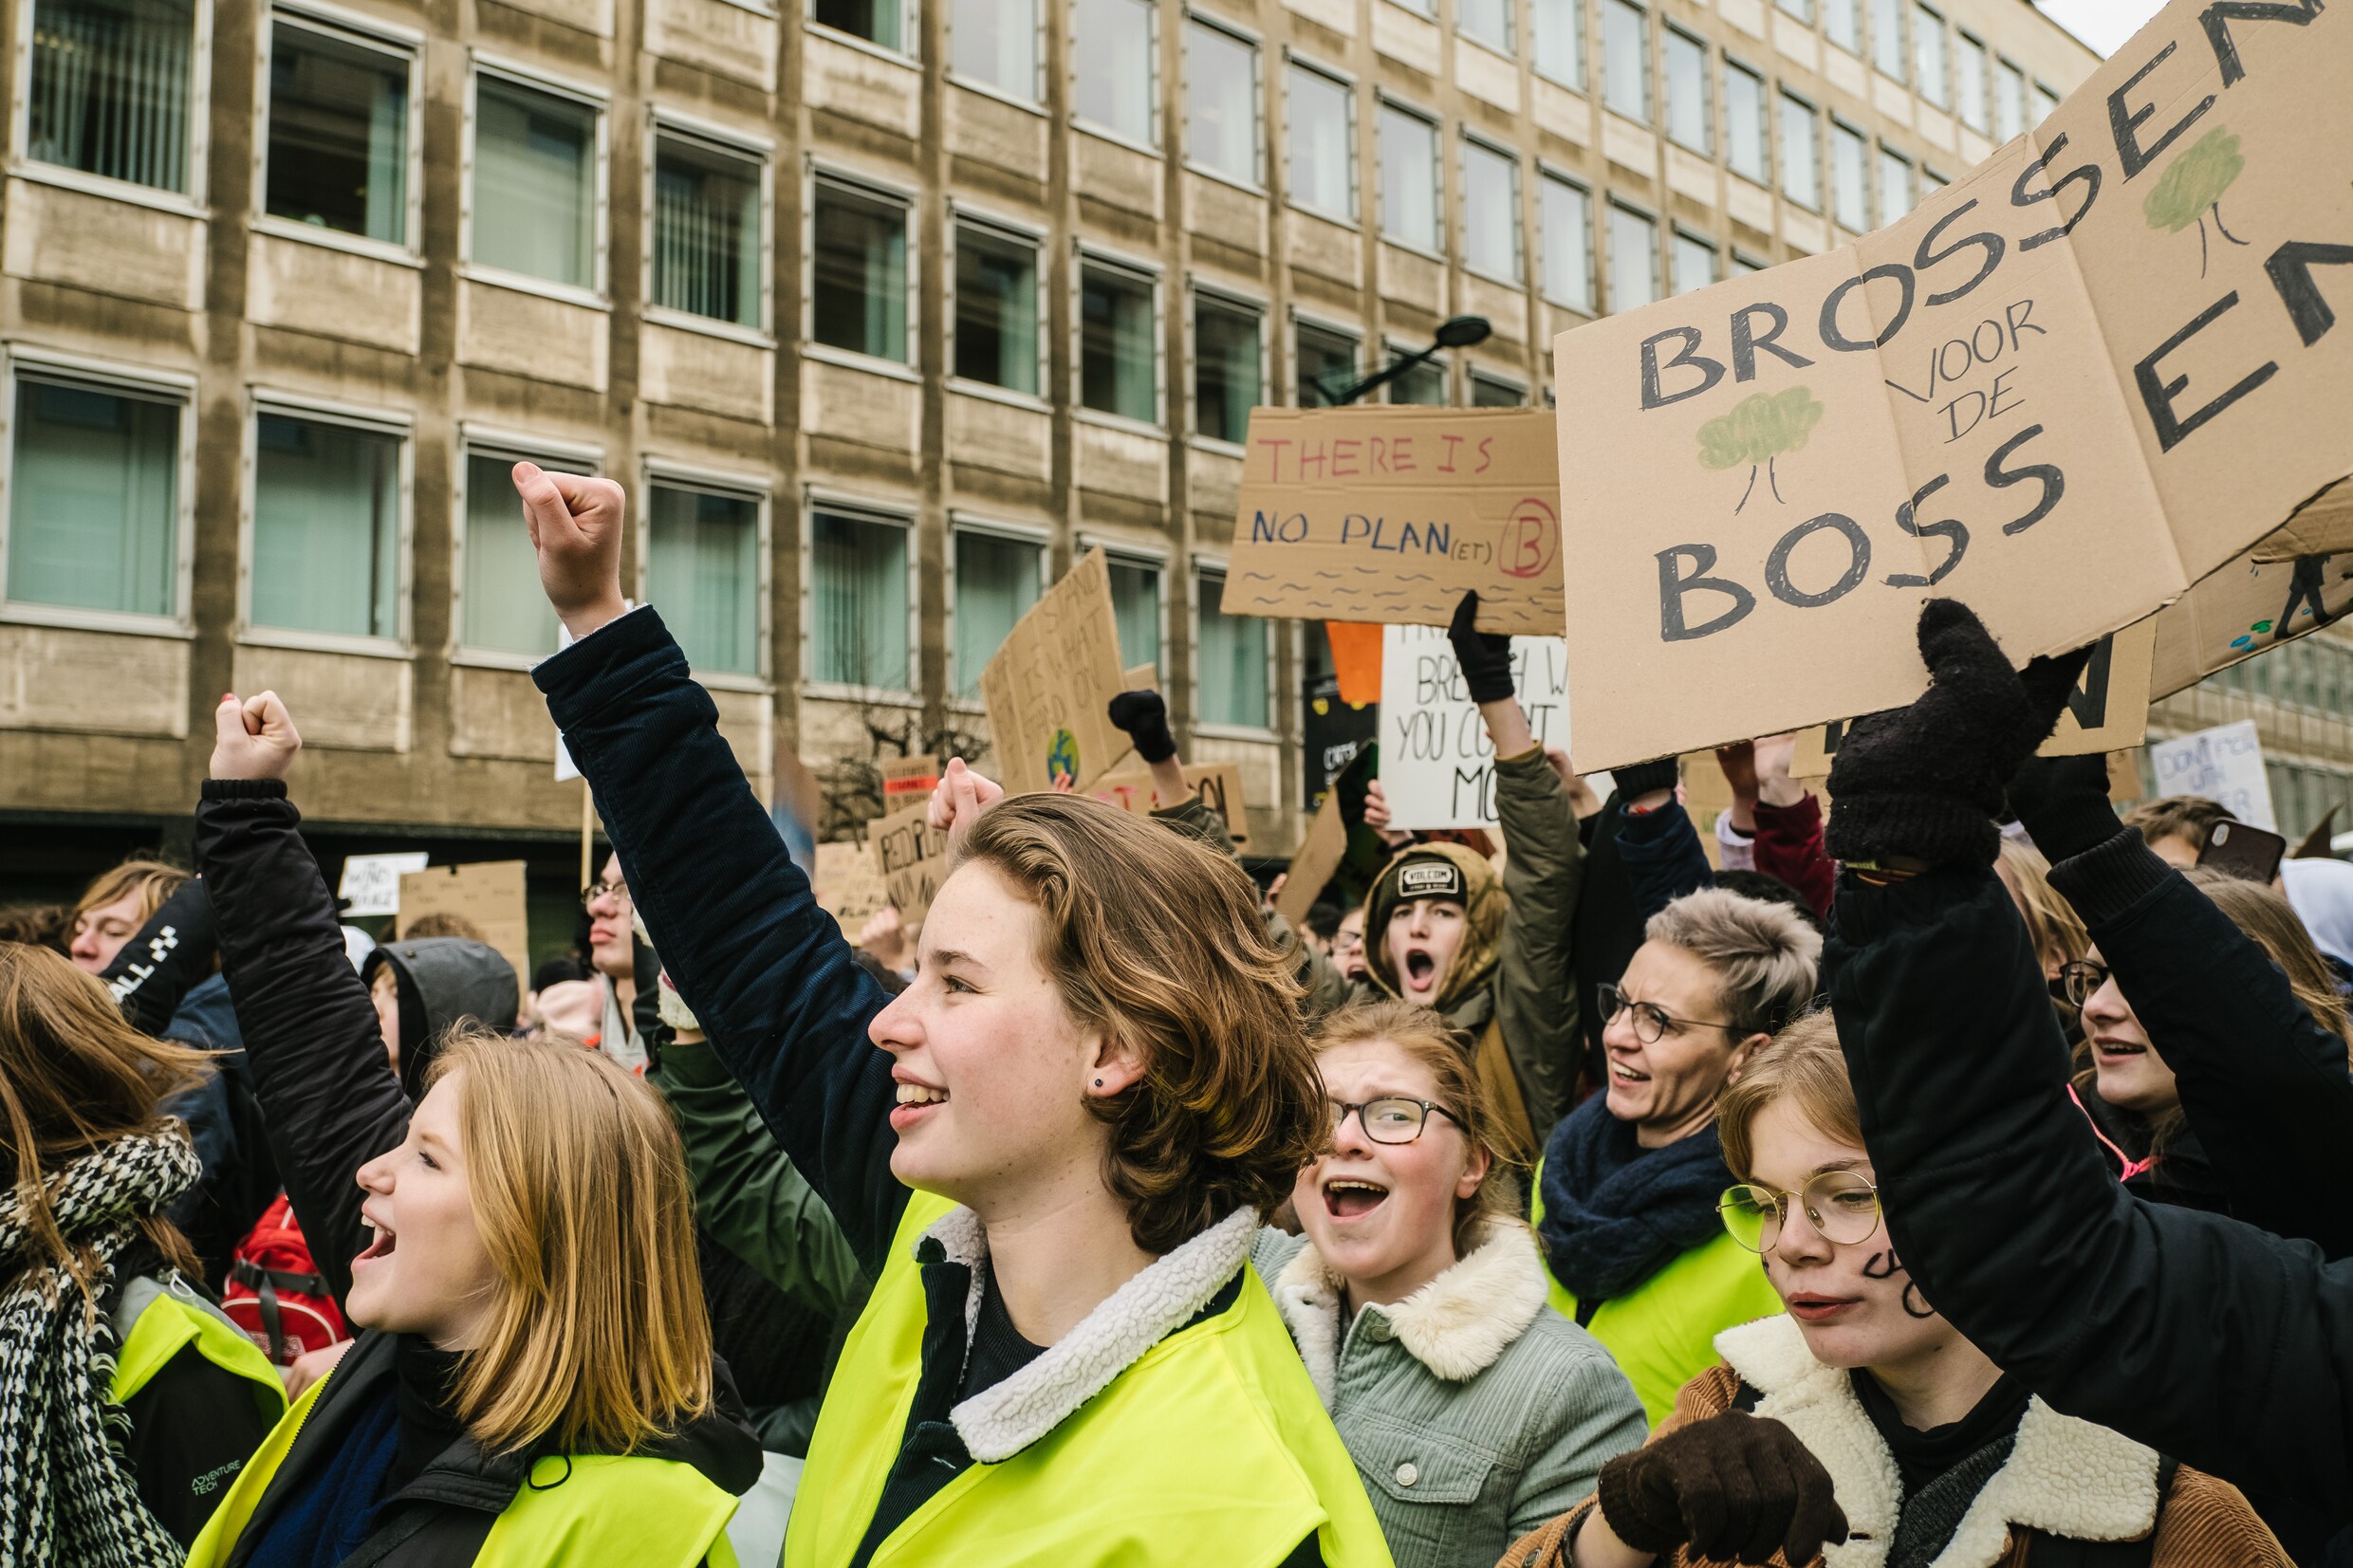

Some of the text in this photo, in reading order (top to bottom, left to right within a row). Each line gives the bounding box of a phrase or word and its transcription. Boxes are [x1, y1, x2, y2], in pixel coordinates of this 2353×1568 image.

[1640, 0, 2325, 411] BROSSEN
[1884, 299, 2047, 403] VOOR
[1936, 366, 2027, 444] DE
[1257, 435, 1494, 483] THERE IS
[1251, 509, 1309, 544] NO
[1397, 709, 1447, 762] YOU
[192, 1459, 241, 1487] ADVENTURE
[192, 1480, 218, 1496] TECH
